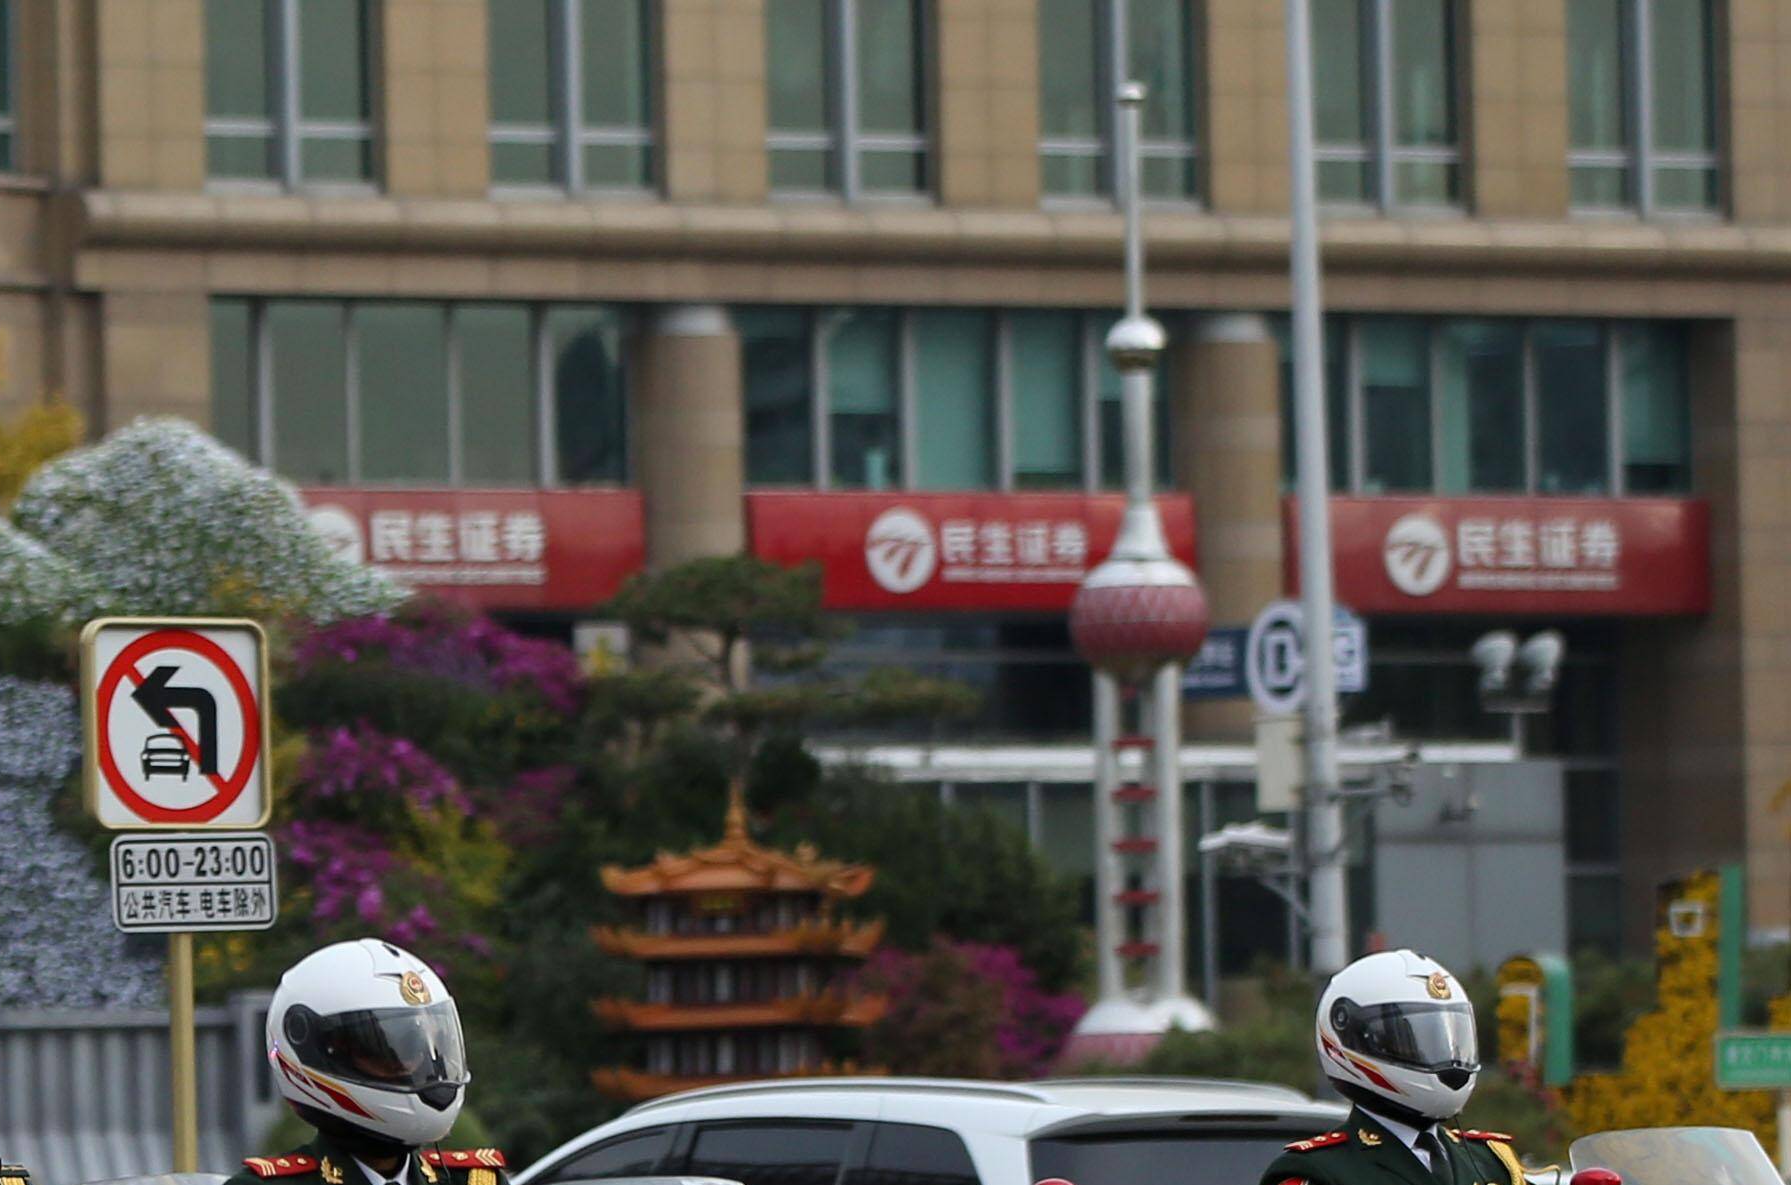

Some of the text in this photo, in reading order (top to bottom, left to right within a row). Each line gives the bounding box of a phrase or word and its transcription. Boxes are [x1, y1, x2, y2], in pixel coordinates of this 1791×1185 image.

[370, 510, 545, 562] 民生证券
[941, 520, 1088, 564] 民生证券
[1457, 519, 1620, 568] 民生证券
[122, 846, 264, 879] 6:00-23:00
